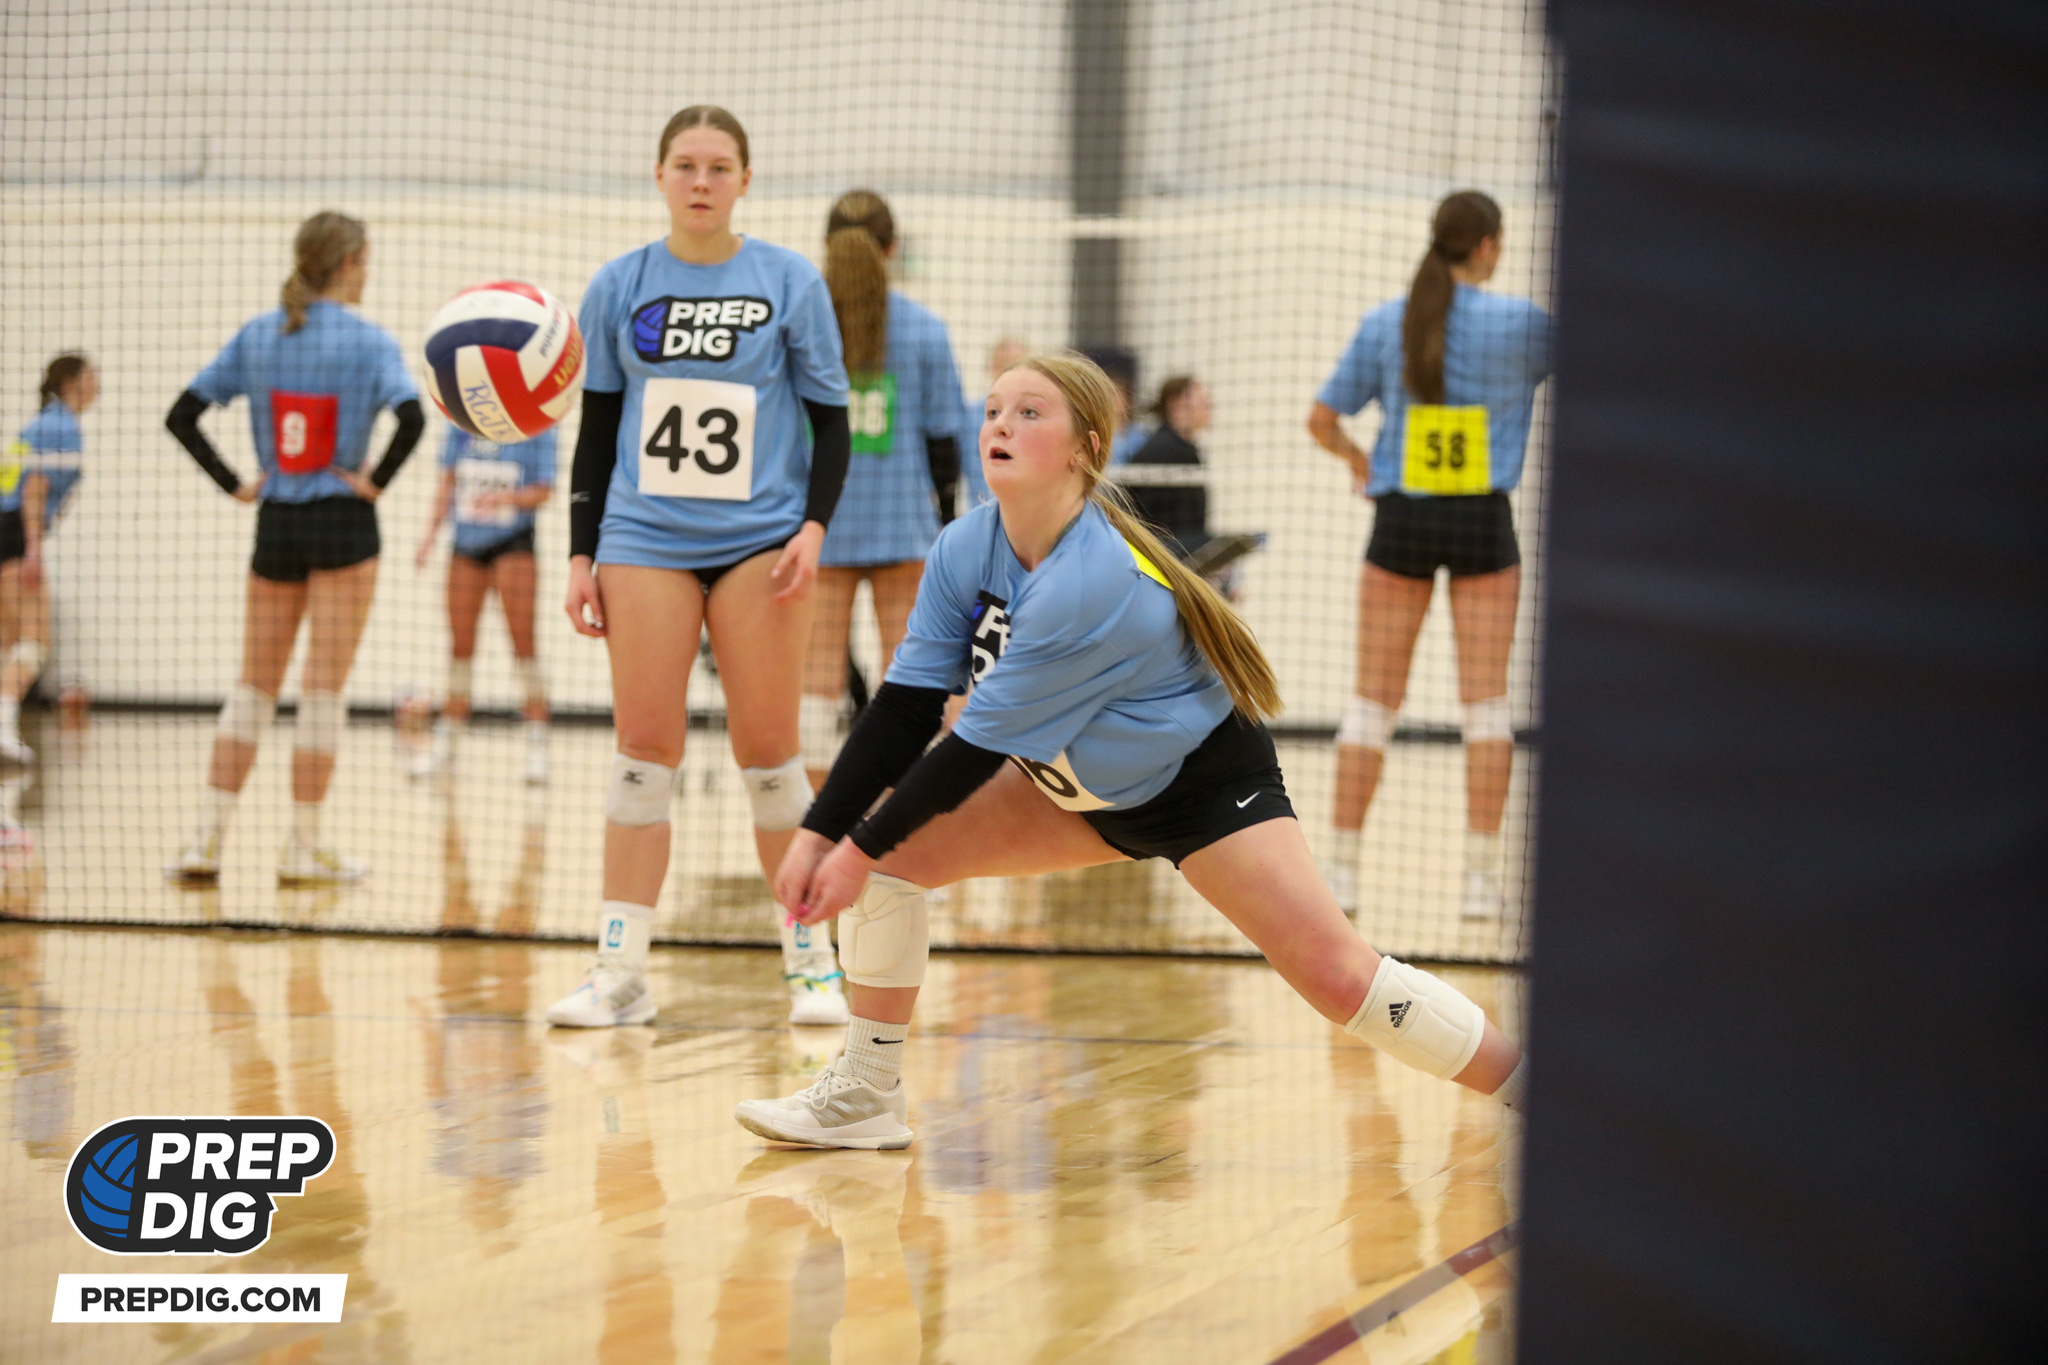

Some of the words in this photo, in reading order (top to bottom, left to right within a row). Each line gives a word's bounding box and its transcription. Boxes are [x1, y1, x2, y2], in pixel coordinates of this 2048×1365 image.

[668, 300, 769, 327] PREP
[663, 328, 732, 357] DIG
[281, 410, 307, 458] 9
[645, 405, 740, 475] 43
[1393, 1000, 1412, 1028] adidas
